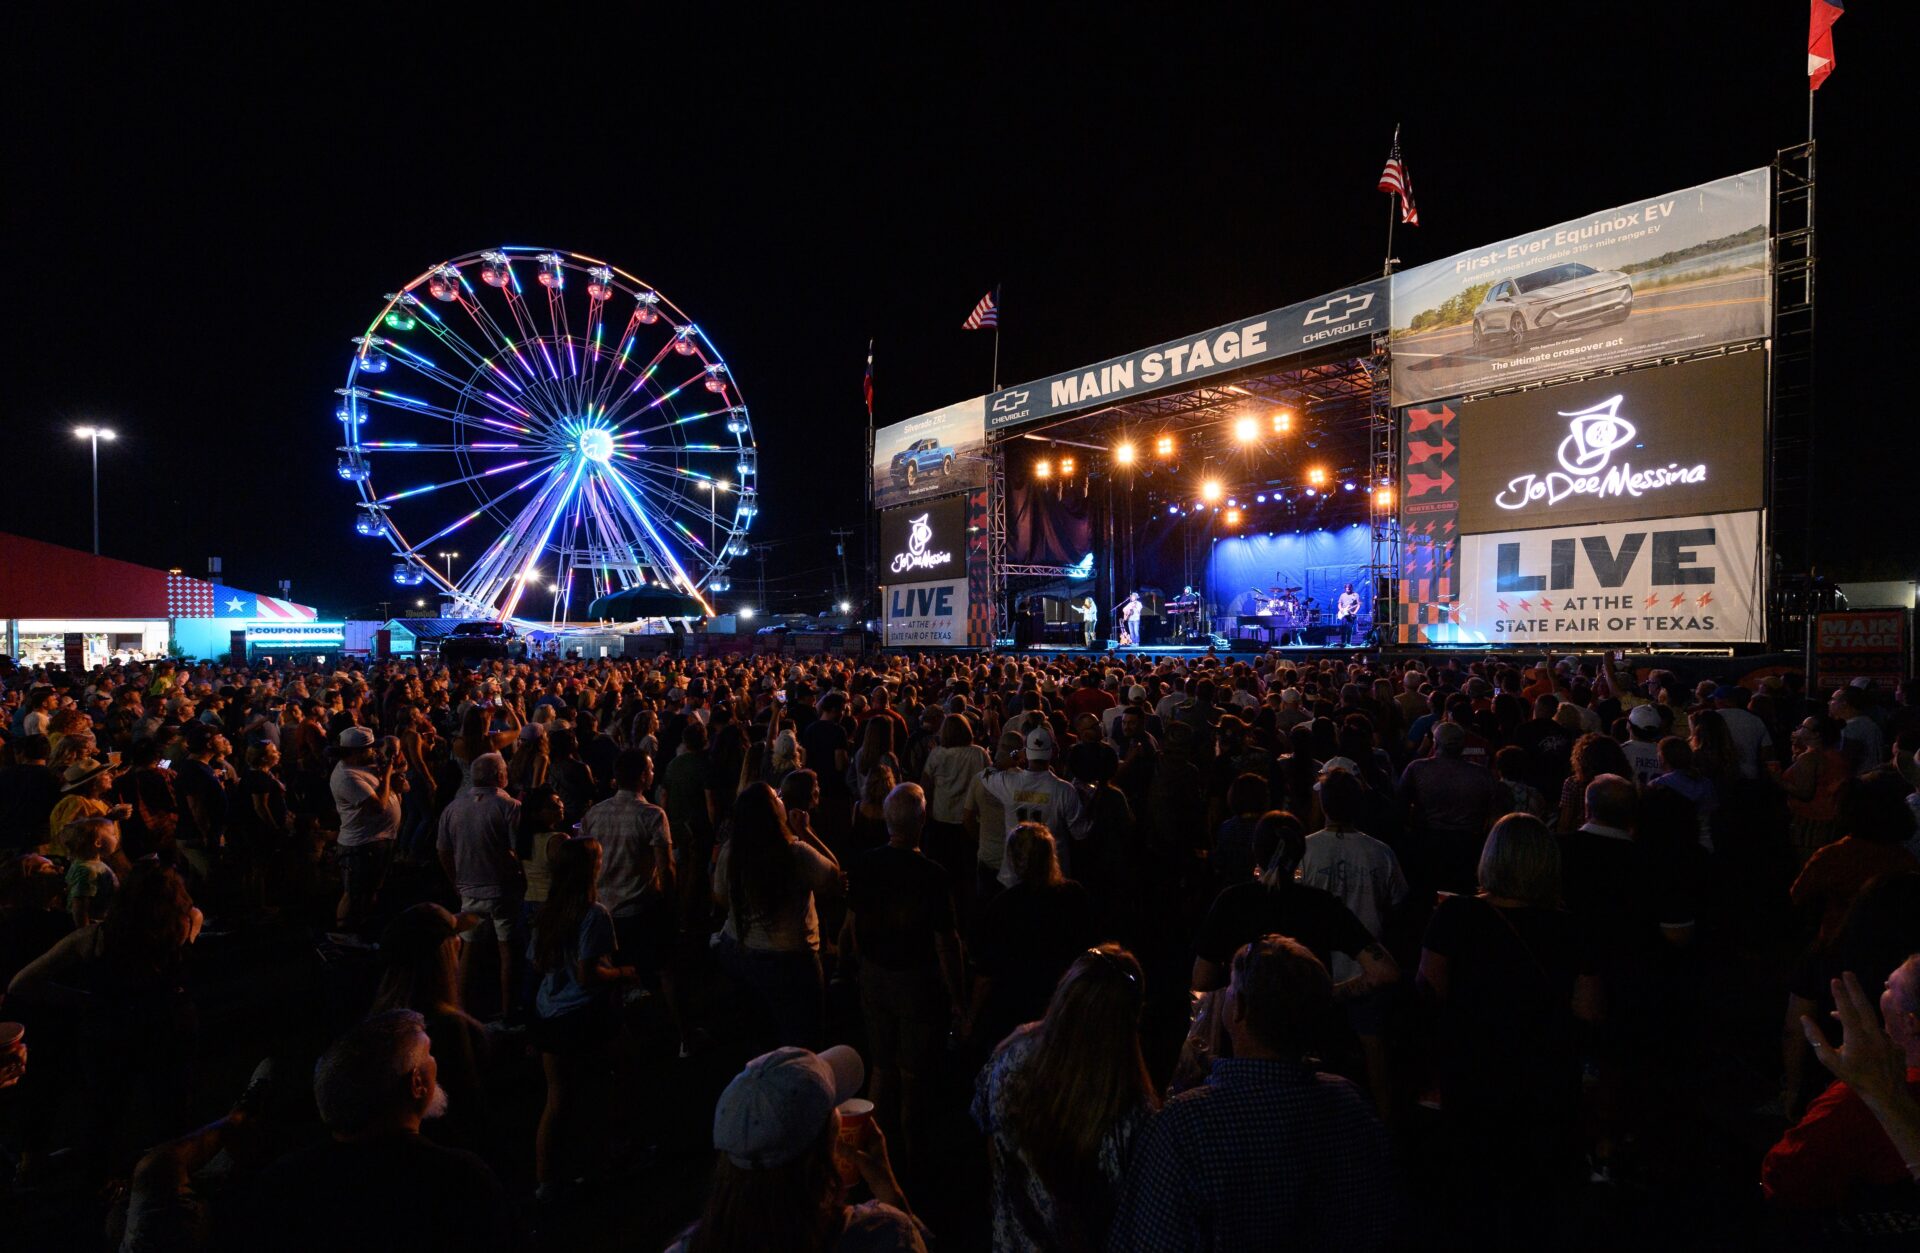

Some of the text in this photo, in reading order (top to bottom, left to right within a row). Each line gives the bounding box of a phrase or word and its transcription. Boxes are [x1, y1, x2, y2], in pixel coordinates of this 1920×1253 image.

[1456, 201, 1676, 274] First-Ever Equinox EV
[1525, 248, 1571, 267] affordable
[1596, 237, 1617, 249] mile
[1618, 229, 1646, 242] range
[1648, 224, 1661, 234] EV
[1302, 317, 1376, 344] CHEVROLET
[1051, 321, 1268, 408] MAIN STAGE
[1491, 362, 1509, 371] The
[1510, 352, 1551, 368] ultimate
[1552, 342, 1604, 359] crossover
[1605, 337, 1624, 348] act
[991, 409, 1030, 425] CHEVROLET
[1599, 462, 1707, 498] Messina
[1497, 528, 1716, 592] LIVE
[892, 586, 954, 618] LIVE
[1563, 595, 1634, 611] AT THE
[905, 632, 919, 641] FAIR
[919, 631, 930, 640] OF
[916, 620, 930, 628] THE
[1495, 618, 1549, 633] STATE
[1554, 617, 1600, 633] FAIR
[1607, 616, 1637, 632] OF
[1822, 618, 1898, 634] MAIN
[1823, 633, 1898, 648] STAGE
